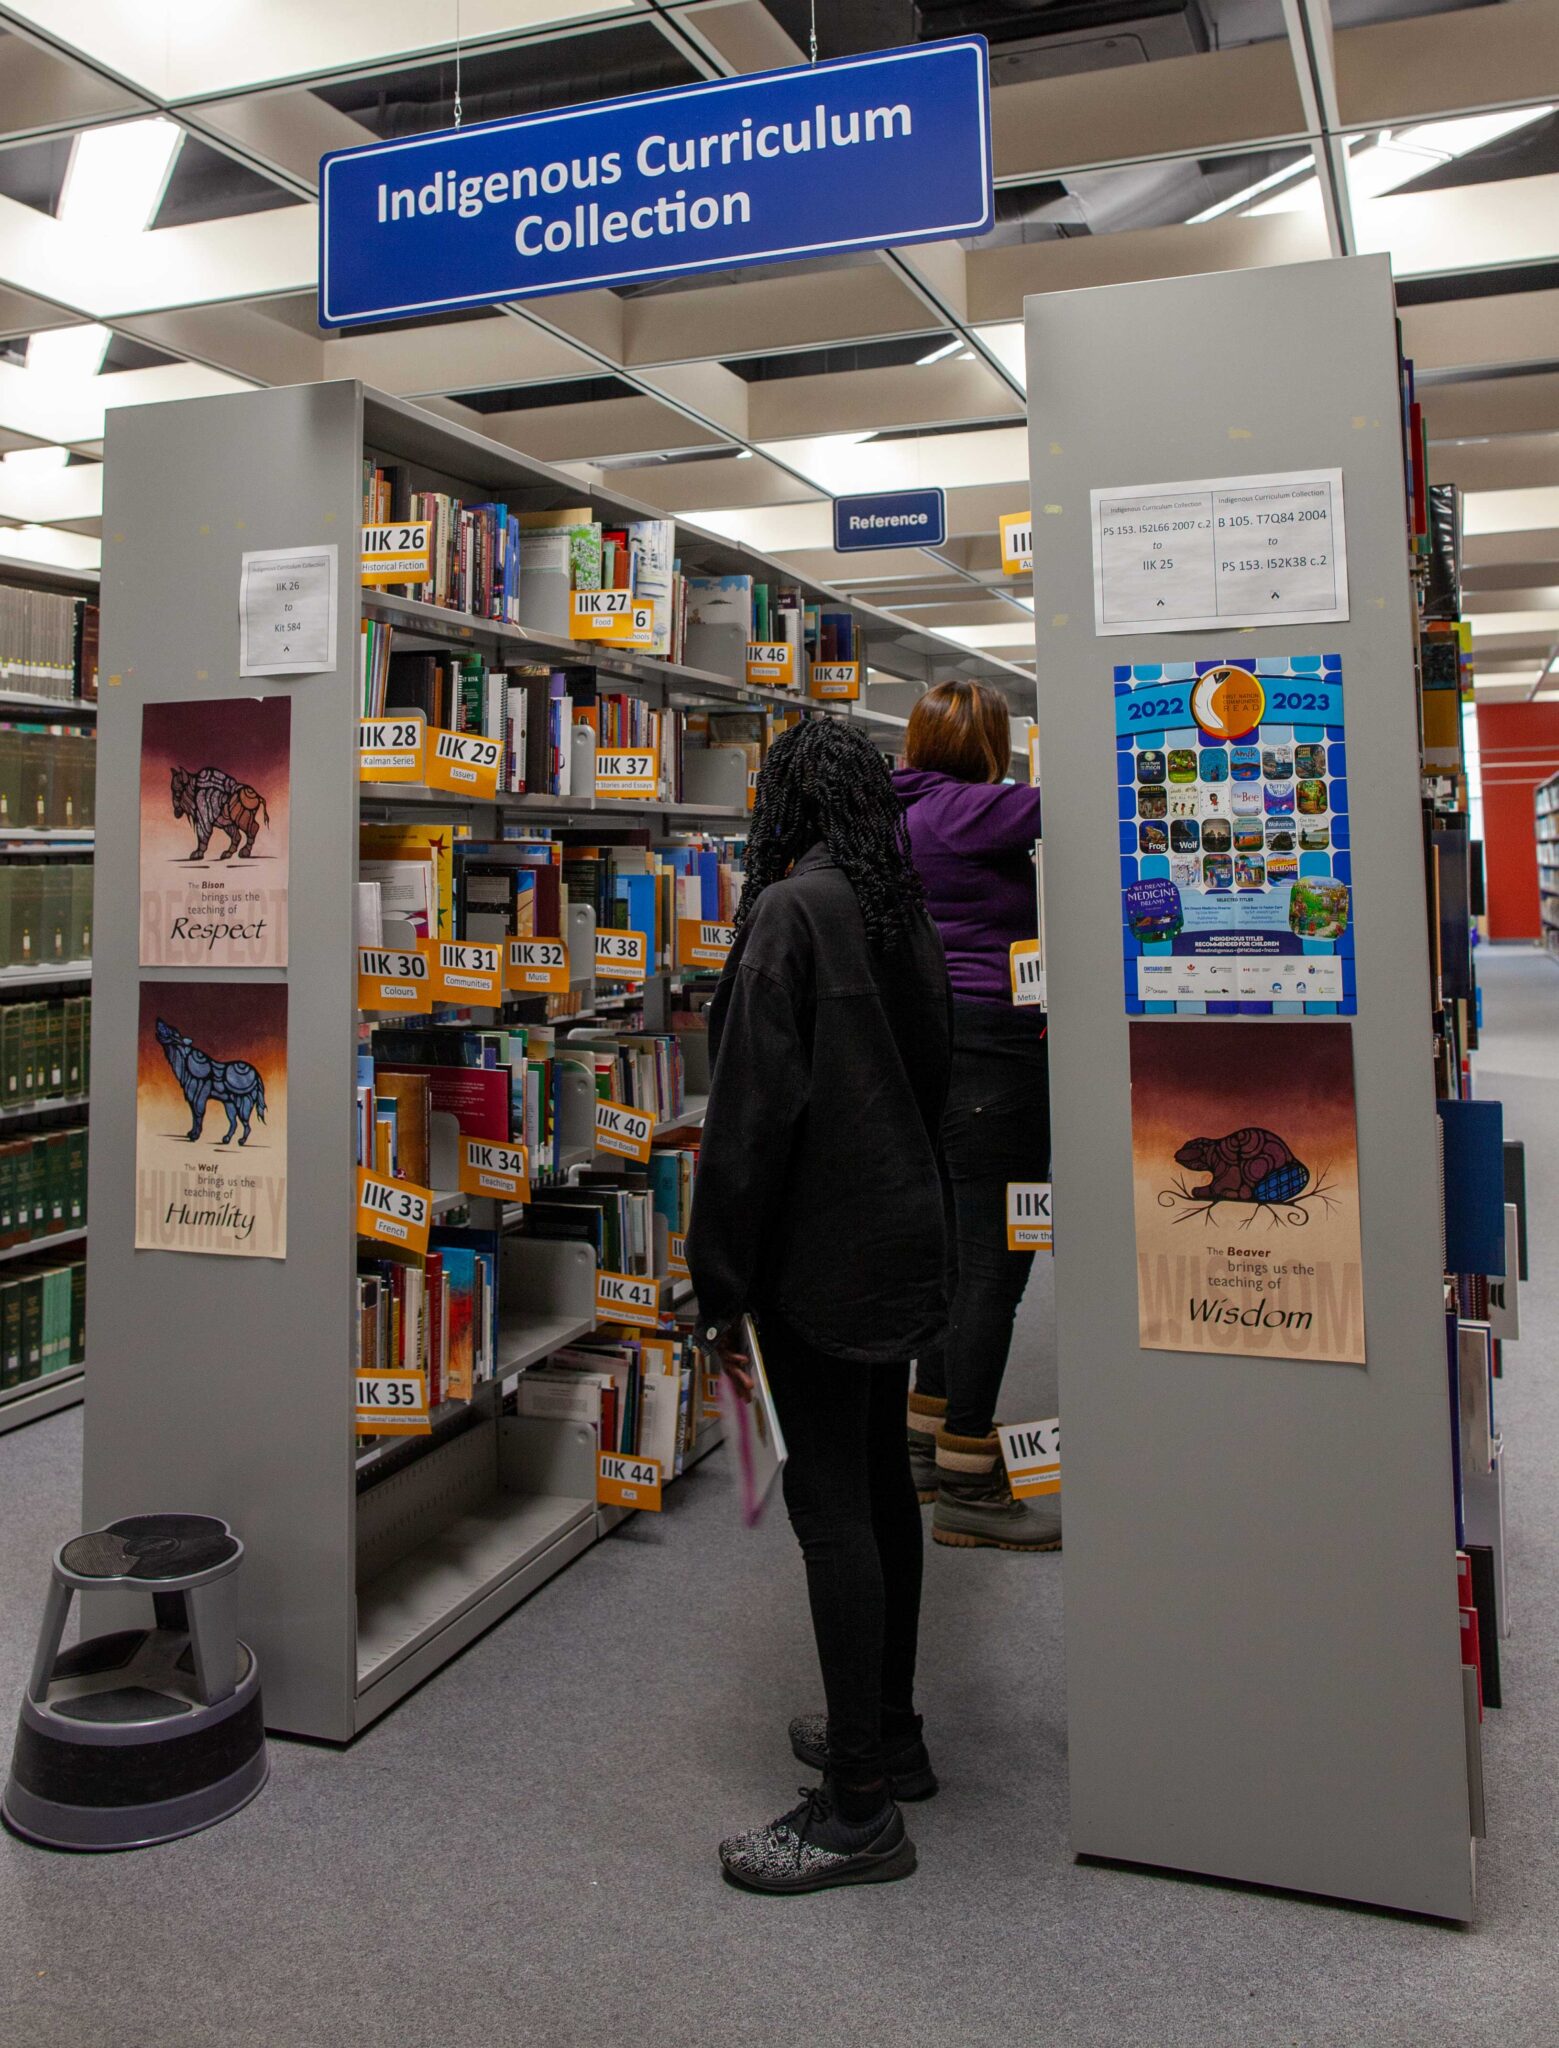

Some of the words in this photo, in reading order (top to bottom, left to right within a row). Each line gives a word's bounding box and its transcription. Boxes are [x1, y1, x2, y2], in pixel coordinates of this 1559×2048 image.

[377, 151, 621, 224] Indigenous
[636, 104, 912, 177] Curriculum
[515, 190, 750, 256] Collection
[1218, 495, 1253, 505] Indigenous
[1254, 491, 1290, 501] Curriculum
[1291, 488, 1325, 498] Collection
[1110, 505, 1141, 514] Indigenous
[1142, 502, 1172, 511] Curriculum
[1173, 500, 1202, 509] Collection
[849, 513, 928, 530] Reference
[1217, 517, 1226, 528] B
[1228, 516, 1253, 527] 105.
[1256, 513, 1295, 526] T7Q84
[1298, 509, 1327, 521] 2004
[1103, 527, 1114, 536] PS
[1117, 524, 1136, 535] 153.
[1138, 522, 1170, 533] I52L66
[1172, 520, 1195, 530] 2007
[1197, 519, 1211, 529] c.2
[365, 530, 392, 551] IIK
[398, 528, 424, 549] 26
[1152, 540, 1162, 550] to
[1268, 535, 1278, 545] to
[362, 562, 397, 571] Historical
[399, 561, 424, 570] Fiction
[1143, 560, 1158, 570] IIK
[1160, 559, 1173, 569] 25
[1221, 561, 1236, 571] PS
[1239, 559, 1264, 571] 153.
[1266, 557, 1307, 569] I52K38
[1310, 554, 1327, 566] c.2
[276, 582, 287, 592] IIK
[289, 581, 300, 590] 26
[284, 603, 293, 611] to
[579, 595, 601, 612] IIK
[606, 594, 627, 611] 27
[274, 623, 285, 632] Kit
[287, 622, 301, 632] 584
[635, 611, 646, 627] 6
[767, 648, 785, 662] 46
[815, 668, 832, 680] IIK
[836, 668, 853, 680] 47
[1127, 697, 1184, 720] 2022
[1223, 703, 1260, 712] READ
[1272, 692, 1330, 711] 2023
[360, 726, 385, 747] IIK
[392, 725, 416, 747] 28
[439, 736, 467, 760] IIK
[470, 743, 497, 765] 29
[1234, 748, 1257, 758] Amik
[364, 756, 390, 765] Kalman
[393, 756, 415, 765] Series
[598, 757, 621, 774] IIK
[626, 757, 648, 774] 37
[452, 768, 475, 780] Issues
[1242, 792, 1259, 802] Bee
[1148, 842, 1167, 852] Frog
[1179, 841, 1197, 849] Wolf
[1267, 864, 1298, 872] ANEMONE
[201, 881, 225, 889] Bison
[201, 892, 229, 904] brings
[245, 892, 260, 901] the
[1127, 887, 1178, 901] MEDICINE
[188, 904, 225, 917] teaching
[228, 904, 237, 914] of
[171, 917, 267, 951] Respect
[703, 927, 720, 944] IIK
[510, 944, 534, 964] IIK
[540, 946, 563, 965] 32
[596, 936, 611, 954] IK
[616, 939, 638, 957] 38
[363, 952, 392, 975] IIK
[399, 955, 425, 978] 30
[442, 945, 467, 968] IIK
[472, 949, 496, 971] 31
[528, 973, 547, 981] Music
[606, 966, 642, 976] Development
[445, 976, 490, 989] Communities
[384, 986, 414, 997] Colours
[597, 1108, 620, 1130] IIK
[624, 1118, 646, 1139] 40
[469, 1143, 492, 1167] IIK
[498, 1151, 522, 1173] 34
[184, 1163, 196, 1171] The
[198, 1163, 219, 1173] Wolf
[197, 1172, 224, 1188] brings
[227, 1178, 238, 1187] us
[240, 1177, 255, 1188] the
[481, 1175, 514, 1190] Teachings
[184, 1188, 220, 1200] teaching
[223, 1190, 234, 1199] of
[364, 1183, 394, 1211] IIK
[398, 1195, 424, 1221] 33
[1017, 1193, 1050, 1216] IIK
[165, 1202, 256, 1240] Humility
[378, 1221, 406, 1238] French
[1018, 1232, 1038, 1240] How
[1206, 1246, 1224, 1256] The
[1227, 1246, 1271, 1258] Beaver
[1228, 1260, 1268, 1276] brings
[1273, 1265, 1288, 1275] us
[1292, 1263, 1314, 1276] the
[600, 1279, 624, 1300] IIK
[629, 1286, 652, 1305] 41
[1208, 1276, 1263, 1292] teaching
[1267, 1277, 1282, 1290] of
[1189, 1298, 1313, 1330] Wisdom
[387, 1383, 415, 1405] 35
[1009, 1431, 1047, 1459] IIK
[602, 1458, 625, 1480] IIK
[631, 1465, 654, 1485] 44
[623, 1490, 634, 1498] Art
